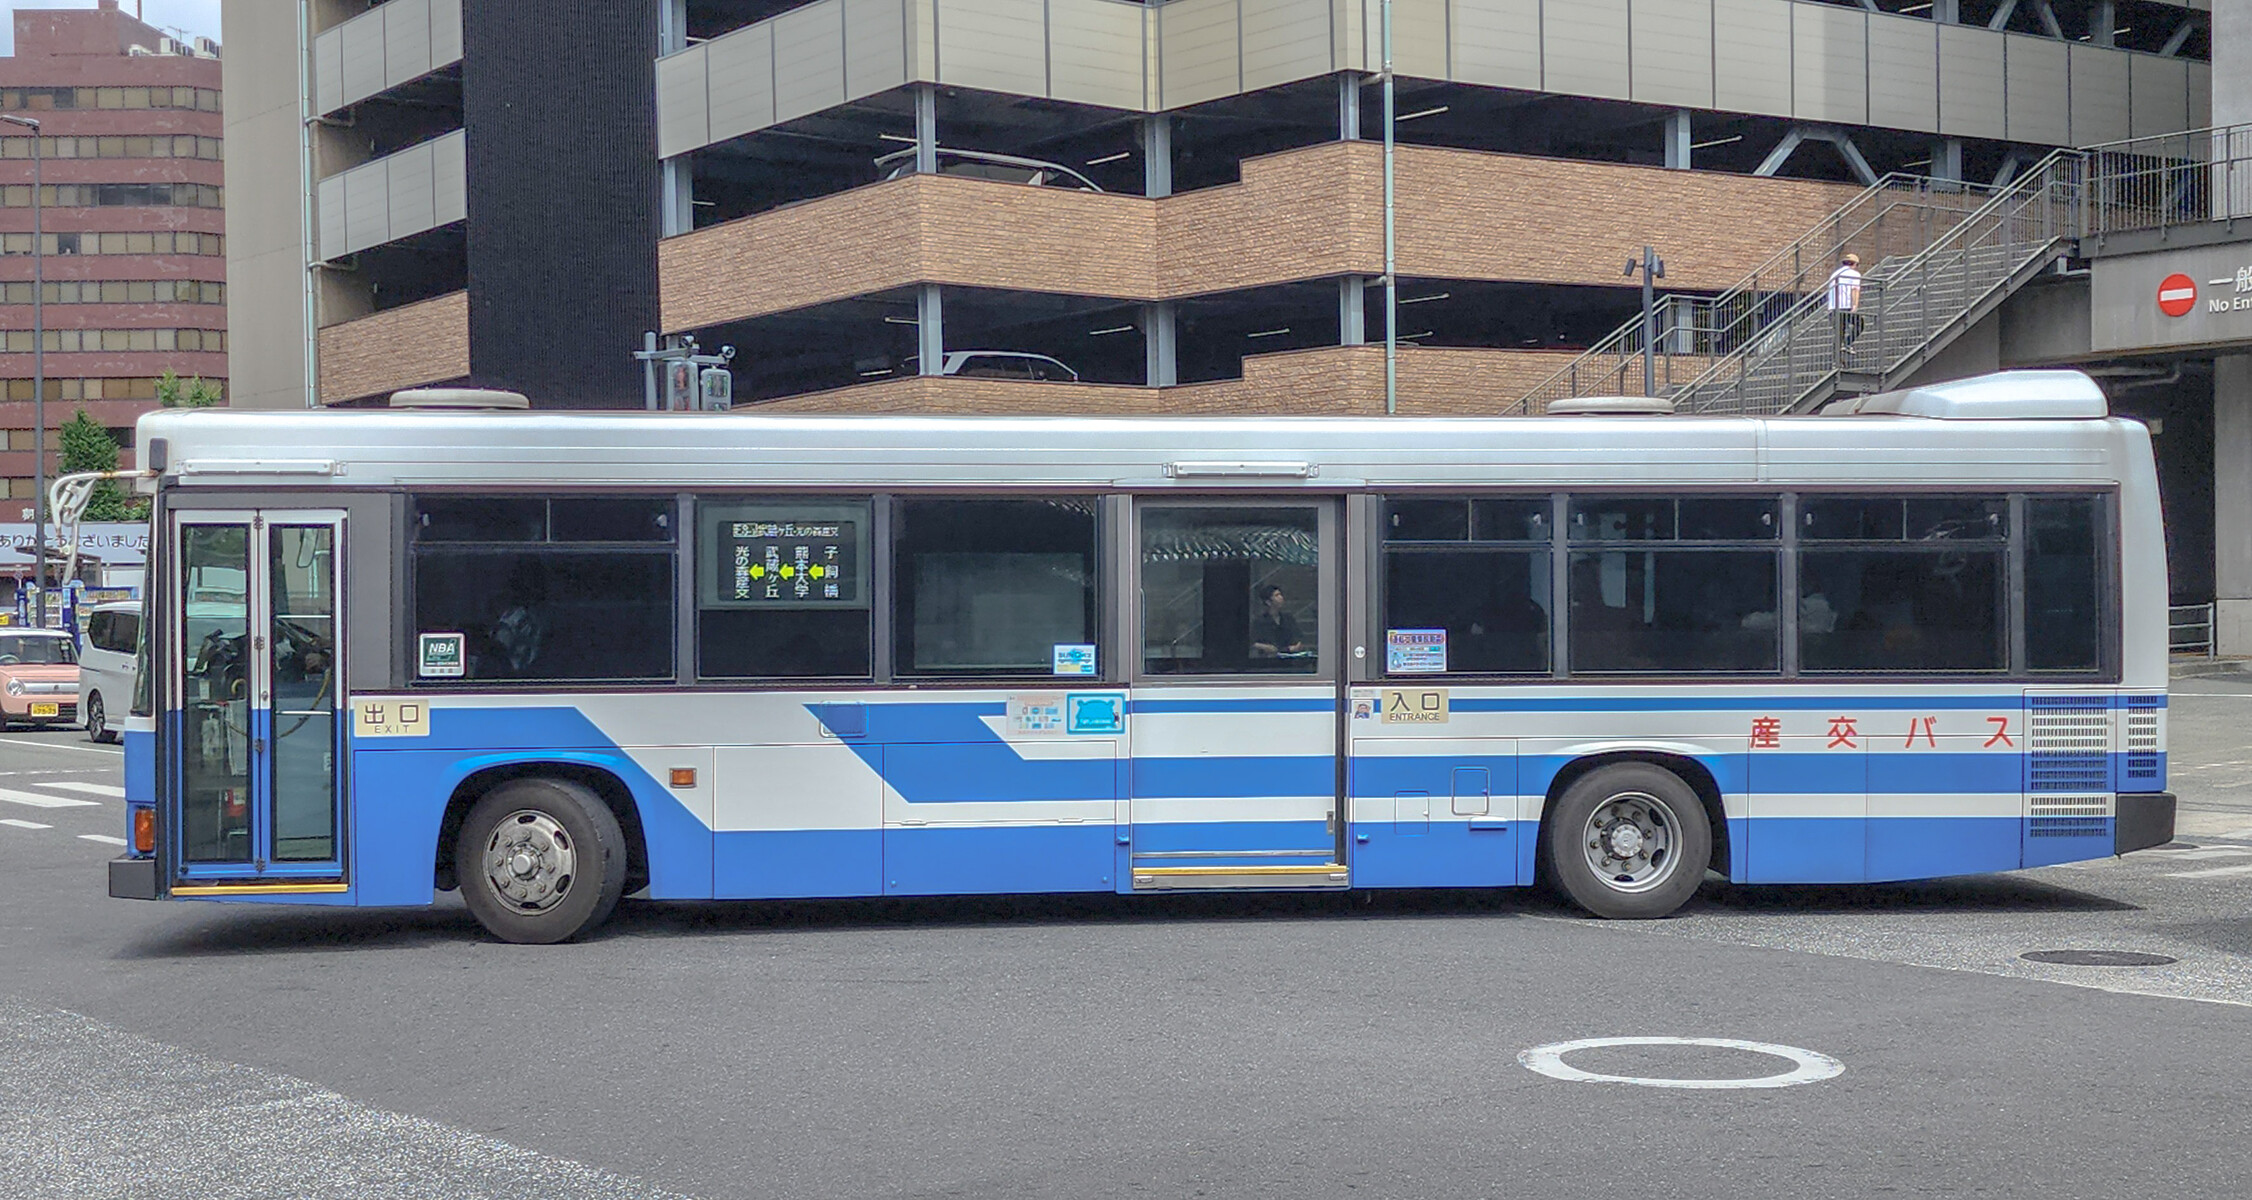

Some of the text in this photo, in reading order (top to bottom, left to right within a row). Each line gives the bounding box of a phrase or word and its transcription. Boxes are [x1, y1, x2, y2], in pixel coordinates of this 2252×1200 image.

[2208, 266, 2252, 293] 一般
[2208, 296, 2252, 313] No En
[0, 534, 149, 548] ありがとうざいました
[794, 546, 810, 598] 熊本大学
[429, 642, 455, 655] NBA
[1390, 692, 1440, 711] 入口
[364, 703, 419, 724] 出口
[1389, 712, 1440, 721] ENTRANCE
[374, 725, 410, 734] EXIT
[1750, 716, 2014, 749] 産交バス
